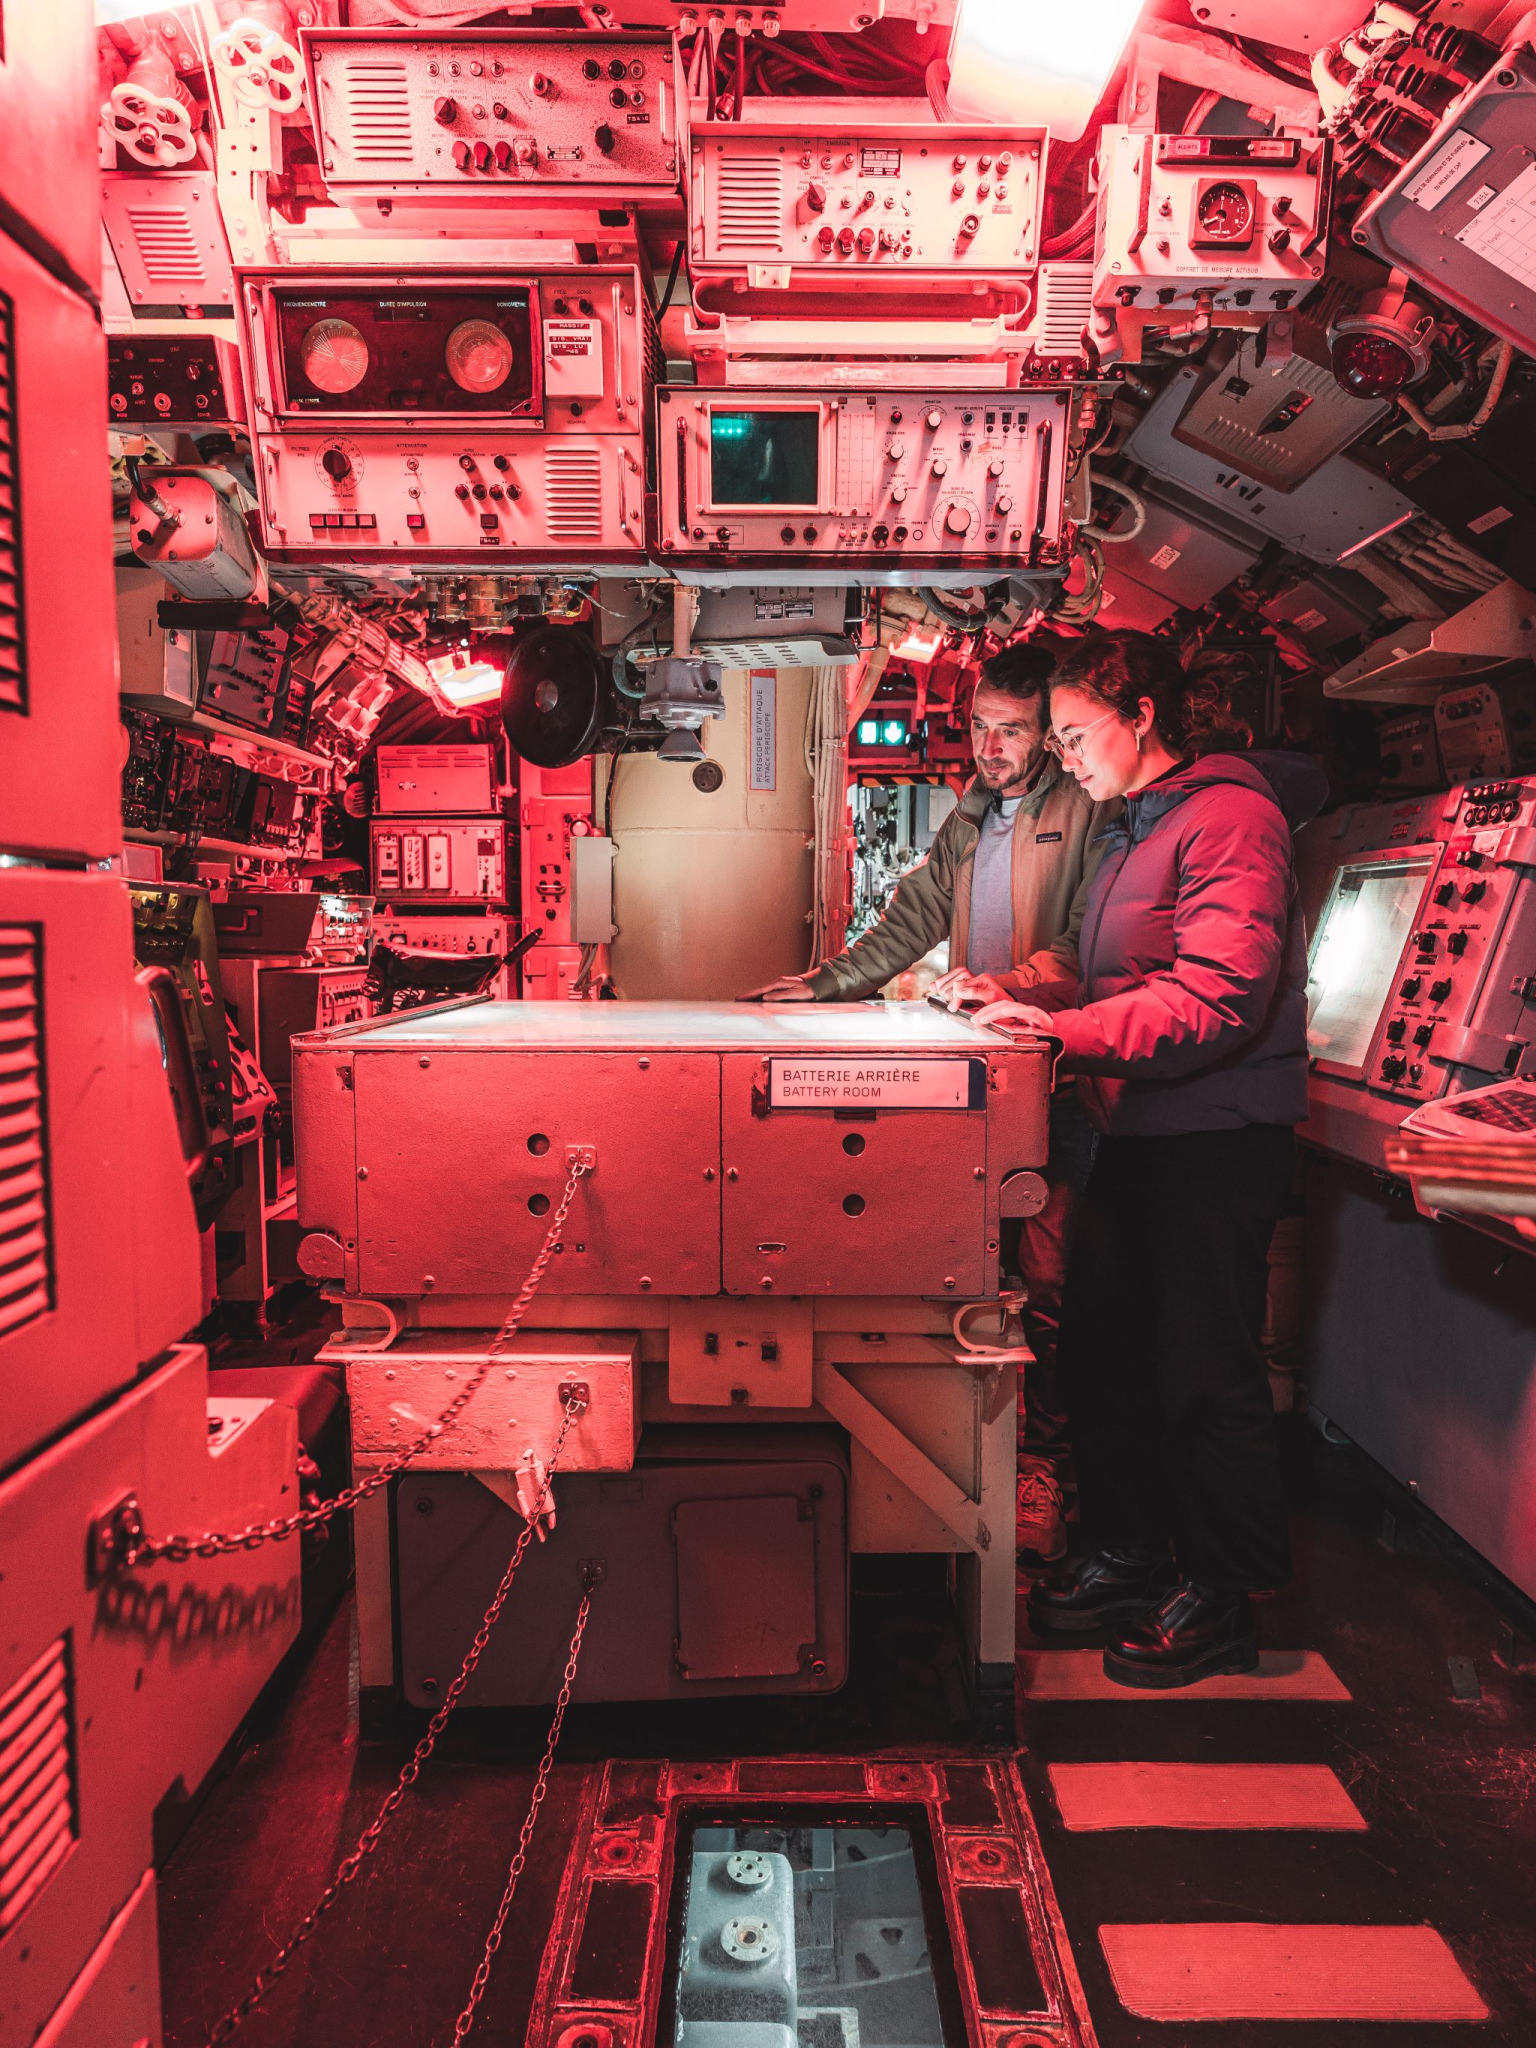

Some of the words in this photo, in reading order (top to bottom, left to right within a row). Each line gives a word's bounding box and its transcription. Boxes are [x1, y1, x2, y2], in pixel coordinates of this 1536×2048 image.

[783, 1070, 851, 1082] BATTERIE
[856, 1068, 921, 1082] ARRIÈRE
[783, 1087, 839, 1097] BATTERY
[843, 1087, 882, 1097] ROOM
